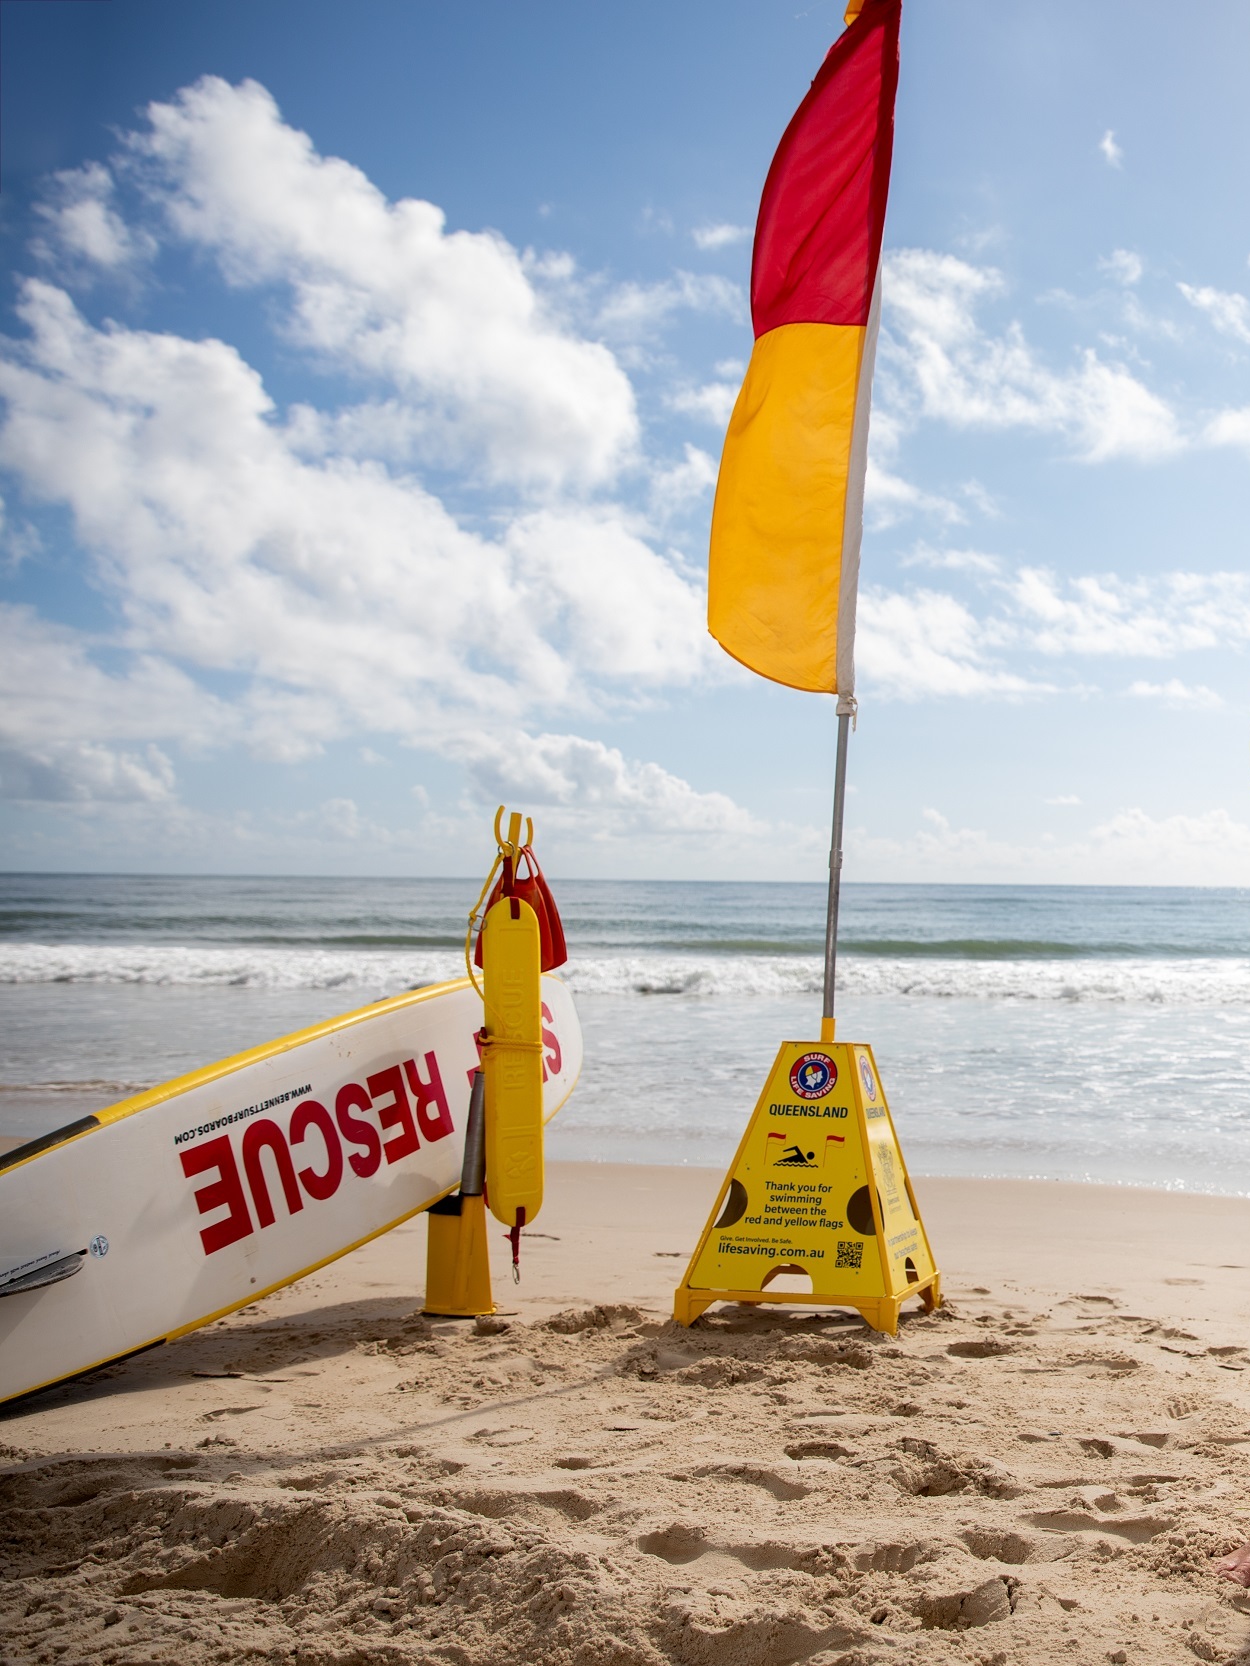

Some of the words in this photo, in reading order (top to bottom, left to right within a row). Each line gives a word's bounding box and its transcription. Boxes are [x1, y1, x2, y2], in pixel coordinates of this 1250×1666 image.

[803, 1053, 831, 1064] SURF
[790, 1075, 803, 1096] LIFE
[804, 1077, 836, 1099] SAVING
[174, 1083, 313, 1146] WWW.BENNETTSURFBOARDS.COM
[769, 1103, 849, 1119] QUEENSLAND
[179, 1050, 455, 1256] RESCUE
[765, 1181, 796, 1191] Thank
[797, 1183, 817, 1194] you
[818, 1182, 833, 1193] for
[769, 1193, 822, 1206] swimming
[764, 1204, 808, 1215] between
[810, 1205, 827, 1216] the
[744, 1215, 761, 1225] red
[763, 1216, 783, 1226] and
[784, 1216, 818, 1228] yellow
[819, 1217, 844, 1230] flags
[745, 1236, 771, 1244] Involved.
[718, 1242, 825, 1259] lifesaving.com.au
